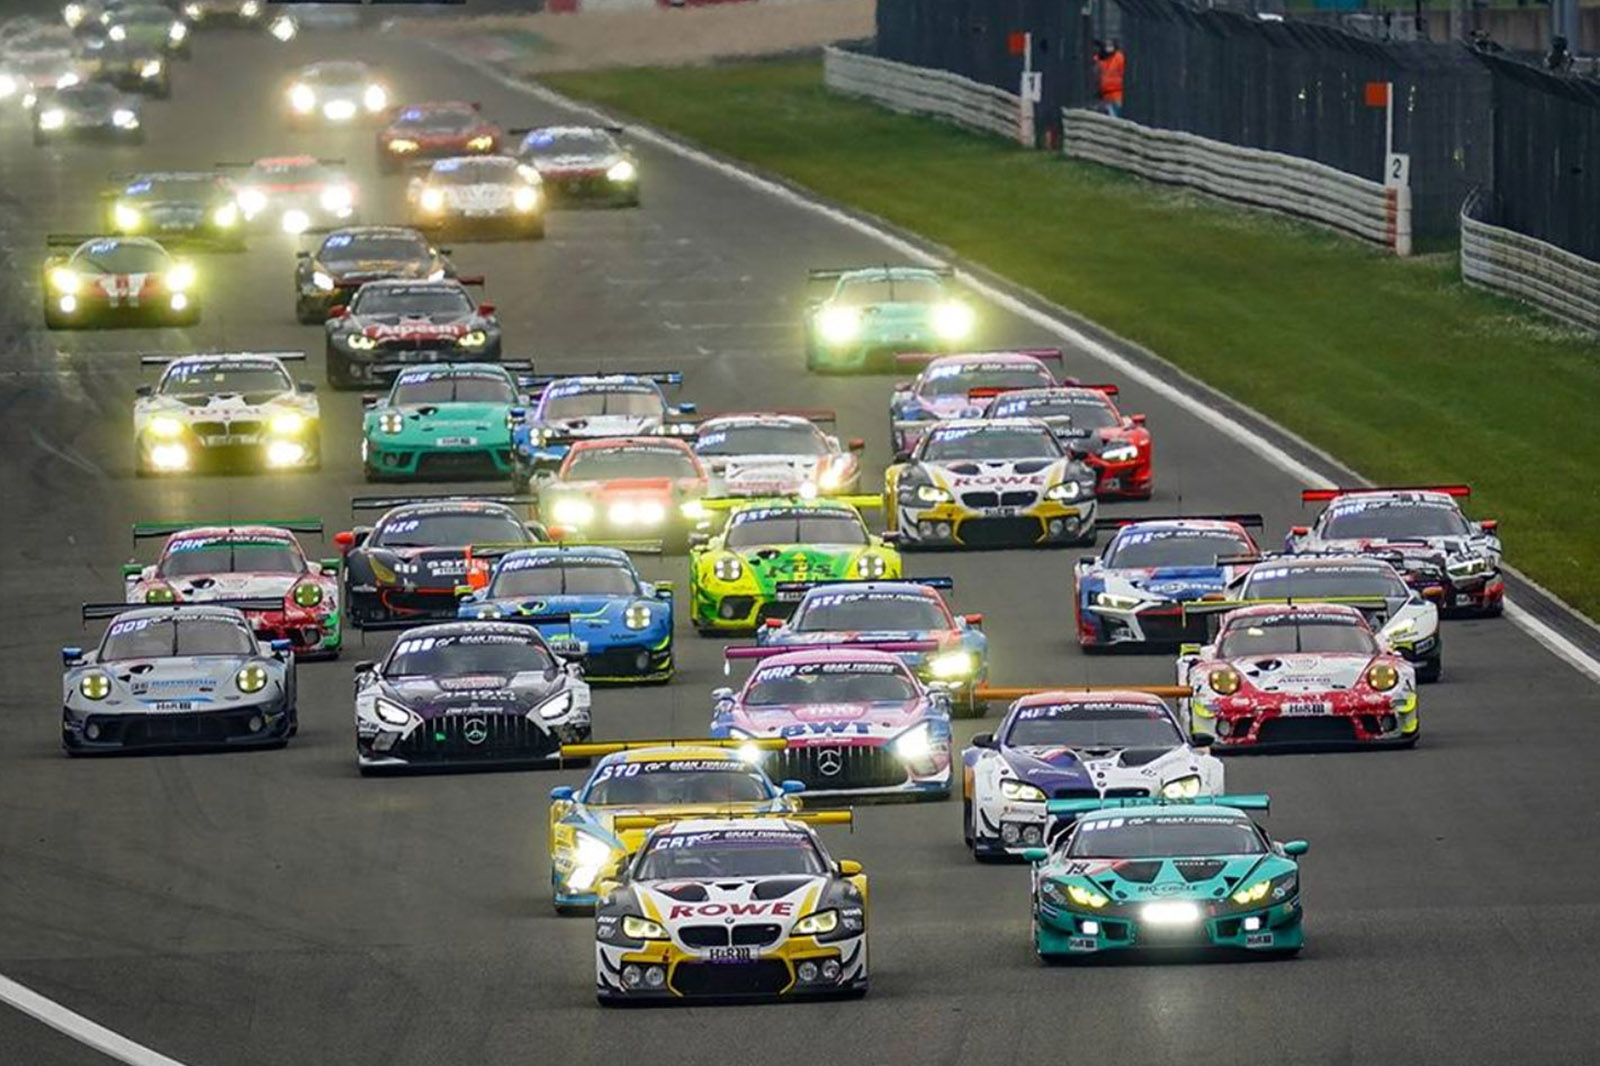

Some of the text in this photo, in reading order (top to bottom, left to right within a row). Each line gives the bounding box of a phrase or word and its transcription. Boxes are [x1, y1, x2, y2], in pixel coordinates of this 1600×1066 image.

[1392, 158, 1402, 179] 2
[954, 476, 1043, 487] ROWE
[756, 665, 797, 681] MAR
[823, 664, 851, 673] GRAN
[780, 720, 872, 737] BWT
[600, 763, 641, 781] STO
[669, 762, 700, 771] GRAN
[1156, 816, 1186, 824] GRAN
[655, 836, 696, 851] CAT
[724, 831, 755, 839] GRAN
[669, 902, 794, 920] ROWE
